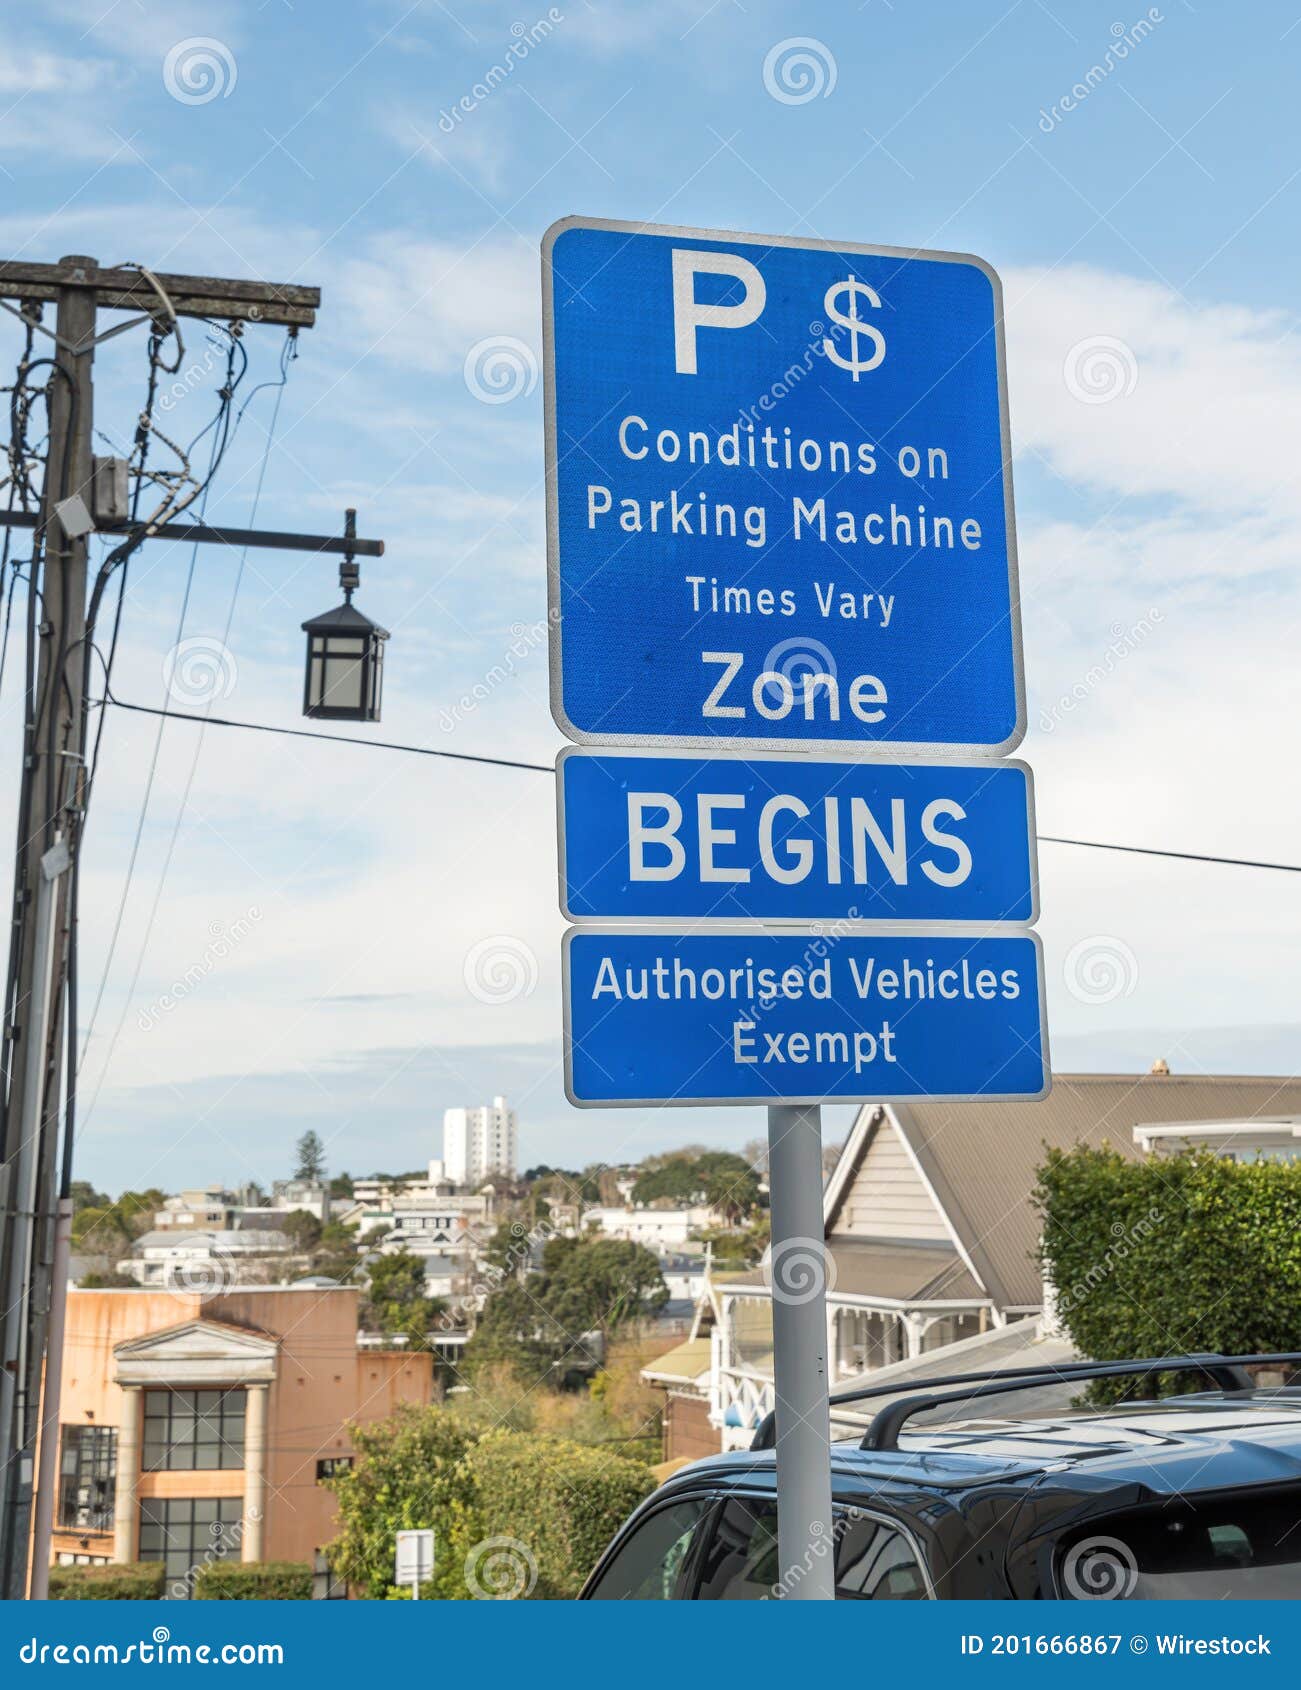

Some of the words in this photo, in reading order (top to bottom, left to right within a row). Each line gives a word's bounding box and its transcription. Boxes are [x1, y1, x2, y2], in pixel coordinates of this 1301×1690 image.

[672, 249, 767, 375] P
[823, 274, 886, 382] $
[619, 416, 876, 475] Conditions
[898, 446, 948, 479] on
[587, 486, 766, 548] Parking
[793, 497, 982, 550] Machine
[685, 576, 796, 616] Times
[814, 582, 895, 627] Vary
[702, 651, 889, 723] Zone
[627, 792, 973, 888] BEGINS
[592, 957, 832, 1000] Authorised
[849, 958, 1020, 1000] Vehicles
[733, 1021, 897, 1074] Exempt
